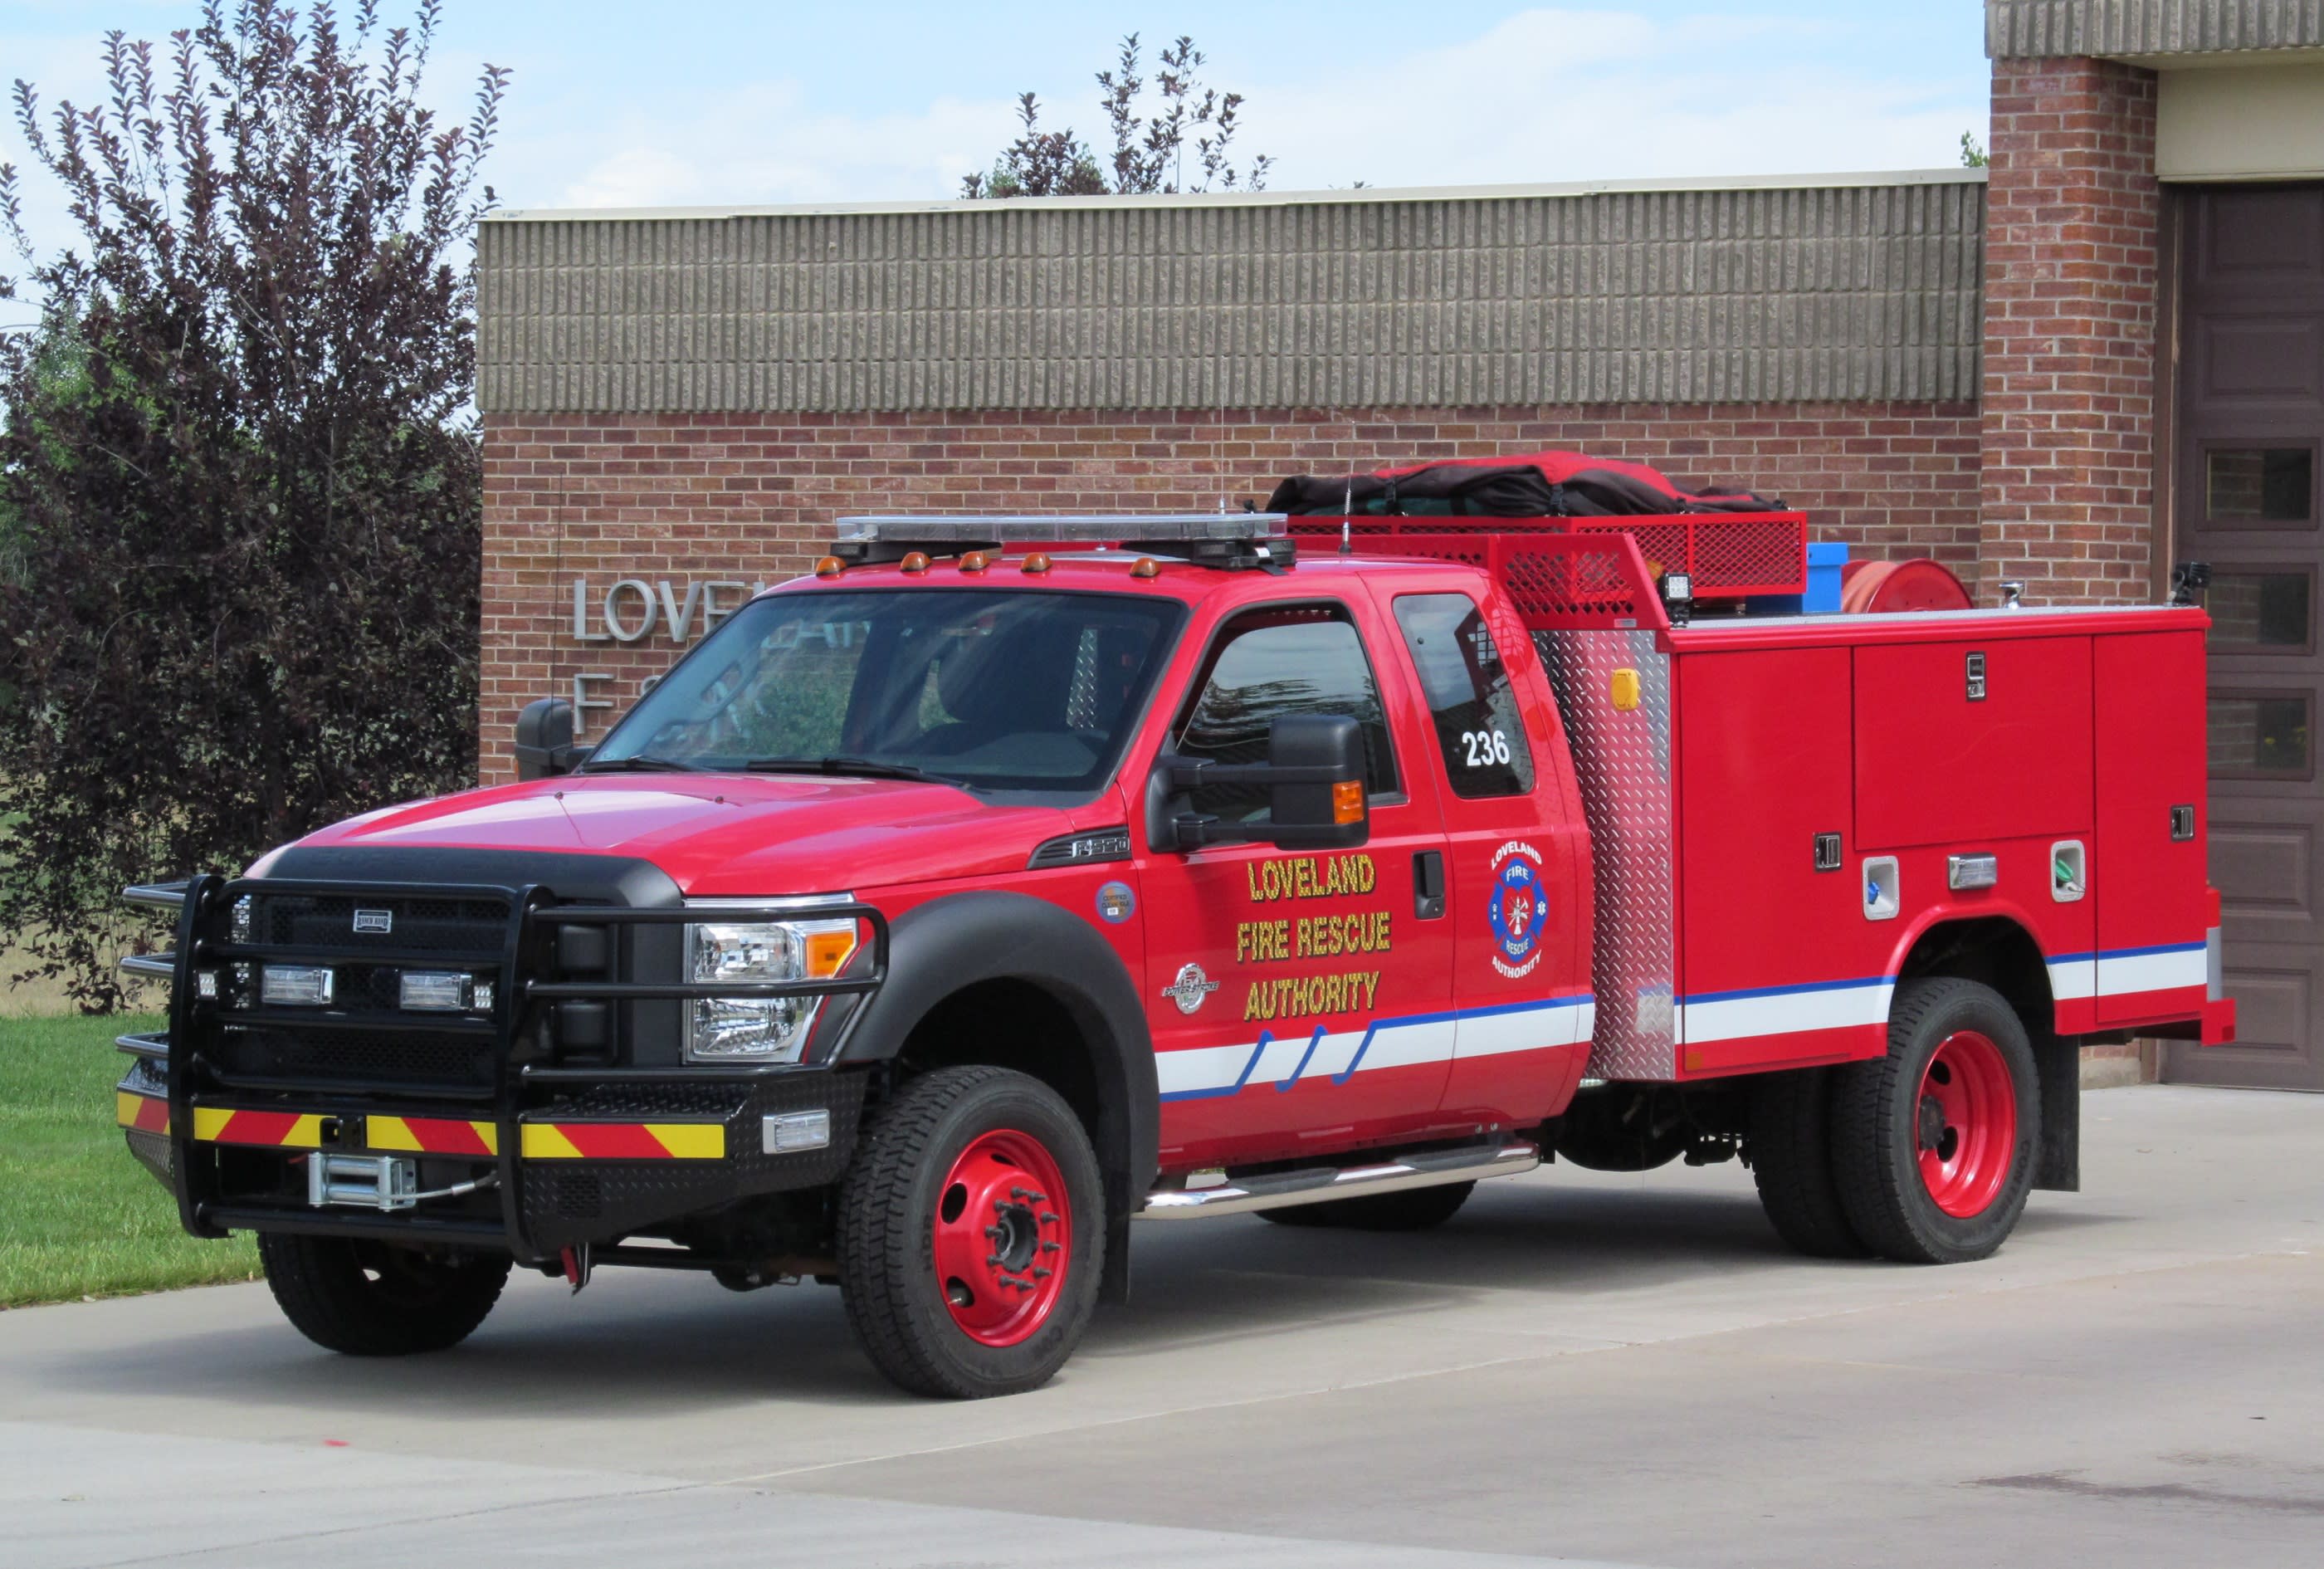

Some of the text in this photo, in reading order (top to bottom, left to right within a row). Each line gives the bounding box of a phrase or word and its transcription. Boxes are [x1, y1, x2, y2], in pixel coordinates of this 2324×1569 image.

[1462, 730, 1510, 766] 236
[1491, 840, 1543, 871] LOVELAND
[1247, 853, 1376, 902] LOVELAND
[1506, 865, 1530, 882] FIRE
[1237, 912, 1393, 963] FIRE RESCUE
[1506, 937, 1530, 956] RESCUE
[1492, 949, 1543, 979] AUTHORITY
[1243, 970, 1380, 1022] AUTHORITY
